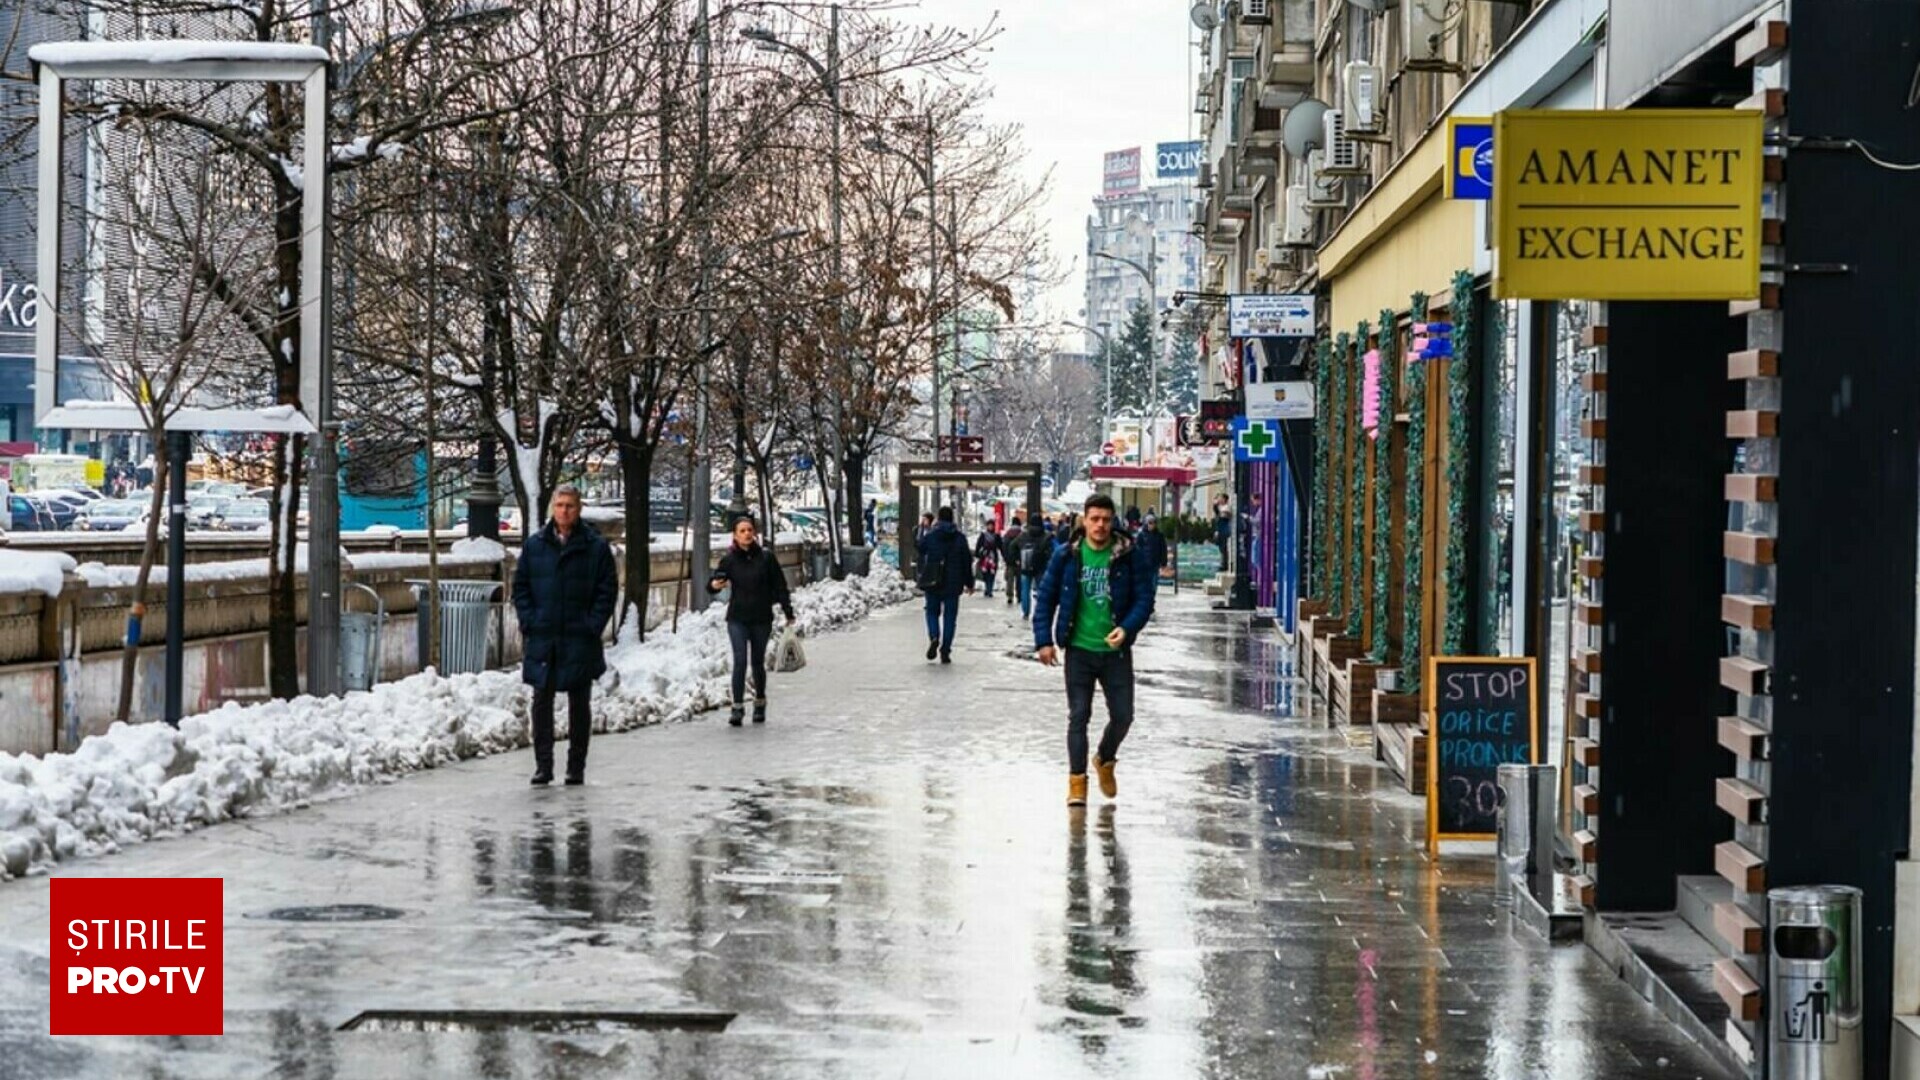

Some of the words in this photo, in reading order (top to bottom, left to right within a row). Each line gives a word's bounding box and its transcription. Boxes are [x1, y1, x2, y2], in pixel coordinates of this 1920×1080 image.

[1517, 149, 1741, 185] AMANET
[1516, 226, 1745, 260] EXCHANGE
[1232, 310, 1252, 319] LAW
[1255, 310, 1286, 319] OFFICE
[1445, 667, 1527, 701] STOP
